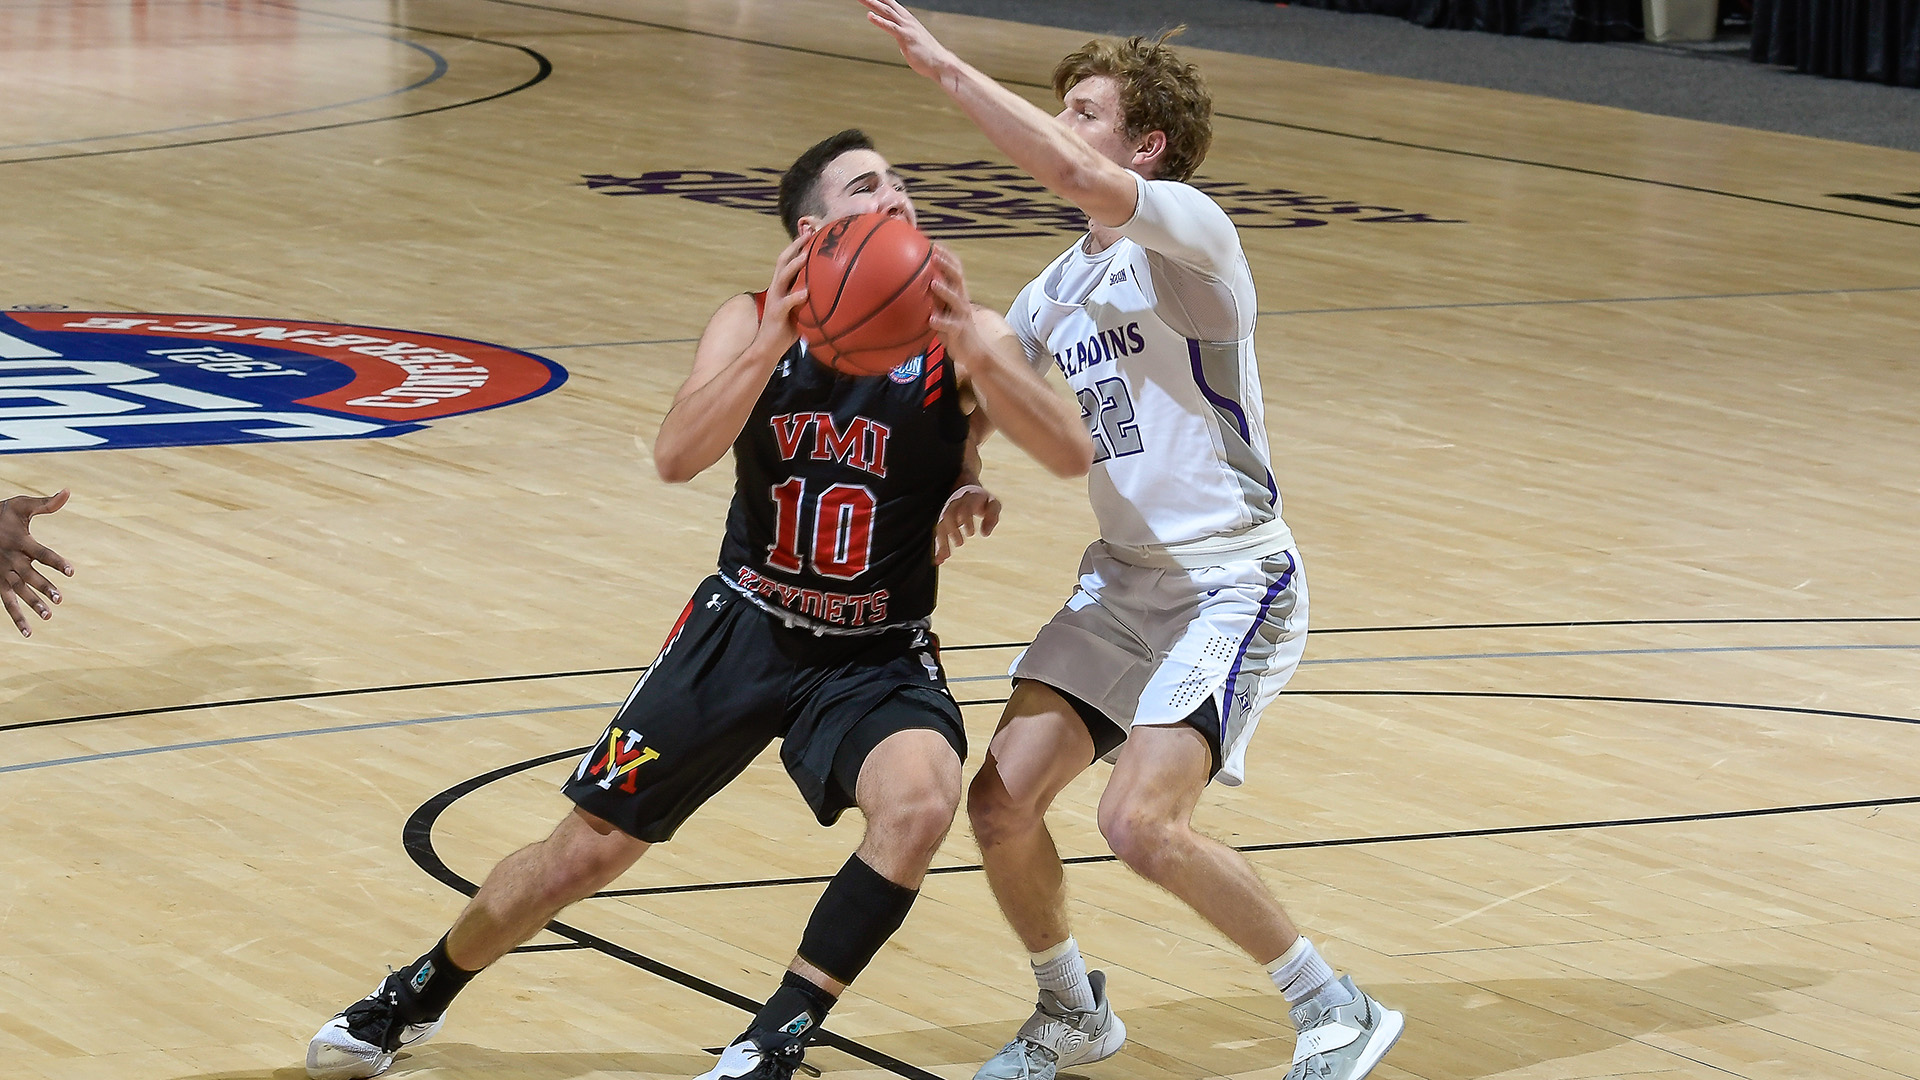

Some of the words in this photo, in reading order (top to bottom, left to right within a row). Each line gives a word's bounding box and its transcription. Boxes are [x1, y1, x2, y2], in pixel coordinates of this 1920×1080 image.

[63, 317, 489, 408] CONFERENCE
[146, 346, 308, 379] 1921
[1052, 322, 1145, 380] ALADINS
[770, 411, 891, 479] VMI
[1076, 376, 1144, 465] 22
[764, 475, 877, 581] 10
